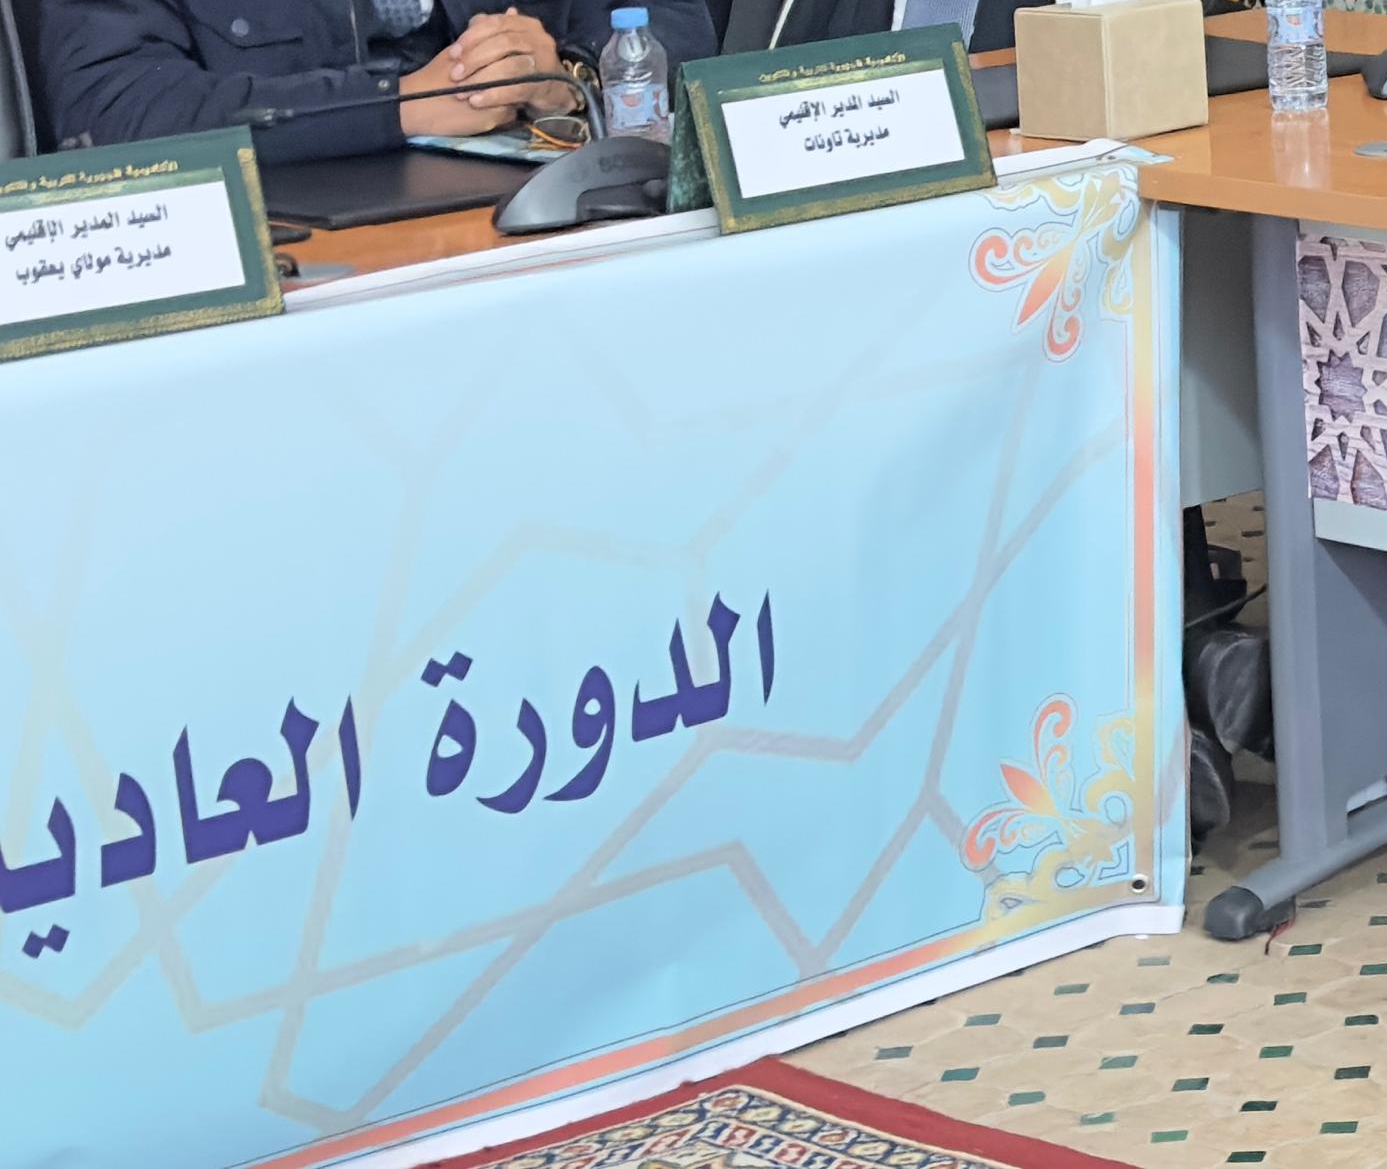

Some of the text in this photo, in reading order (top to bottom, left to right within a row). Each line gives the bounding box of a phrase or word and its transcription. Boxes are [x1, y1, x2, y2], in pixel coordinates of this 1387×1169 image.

[831, 94, 863, 118] المدير
[868, 88, 901, 110] السيد
[804, 125, 890, 153] مديرية تاونات
[71, 211, 120, 239] المدير
[127, 203, 169, 228] السيد
[114, 243, 172, 270] مديرية
[16, 259, 65, 285] يعقوب
[0, 588, 776, 960] الدورة العادي
